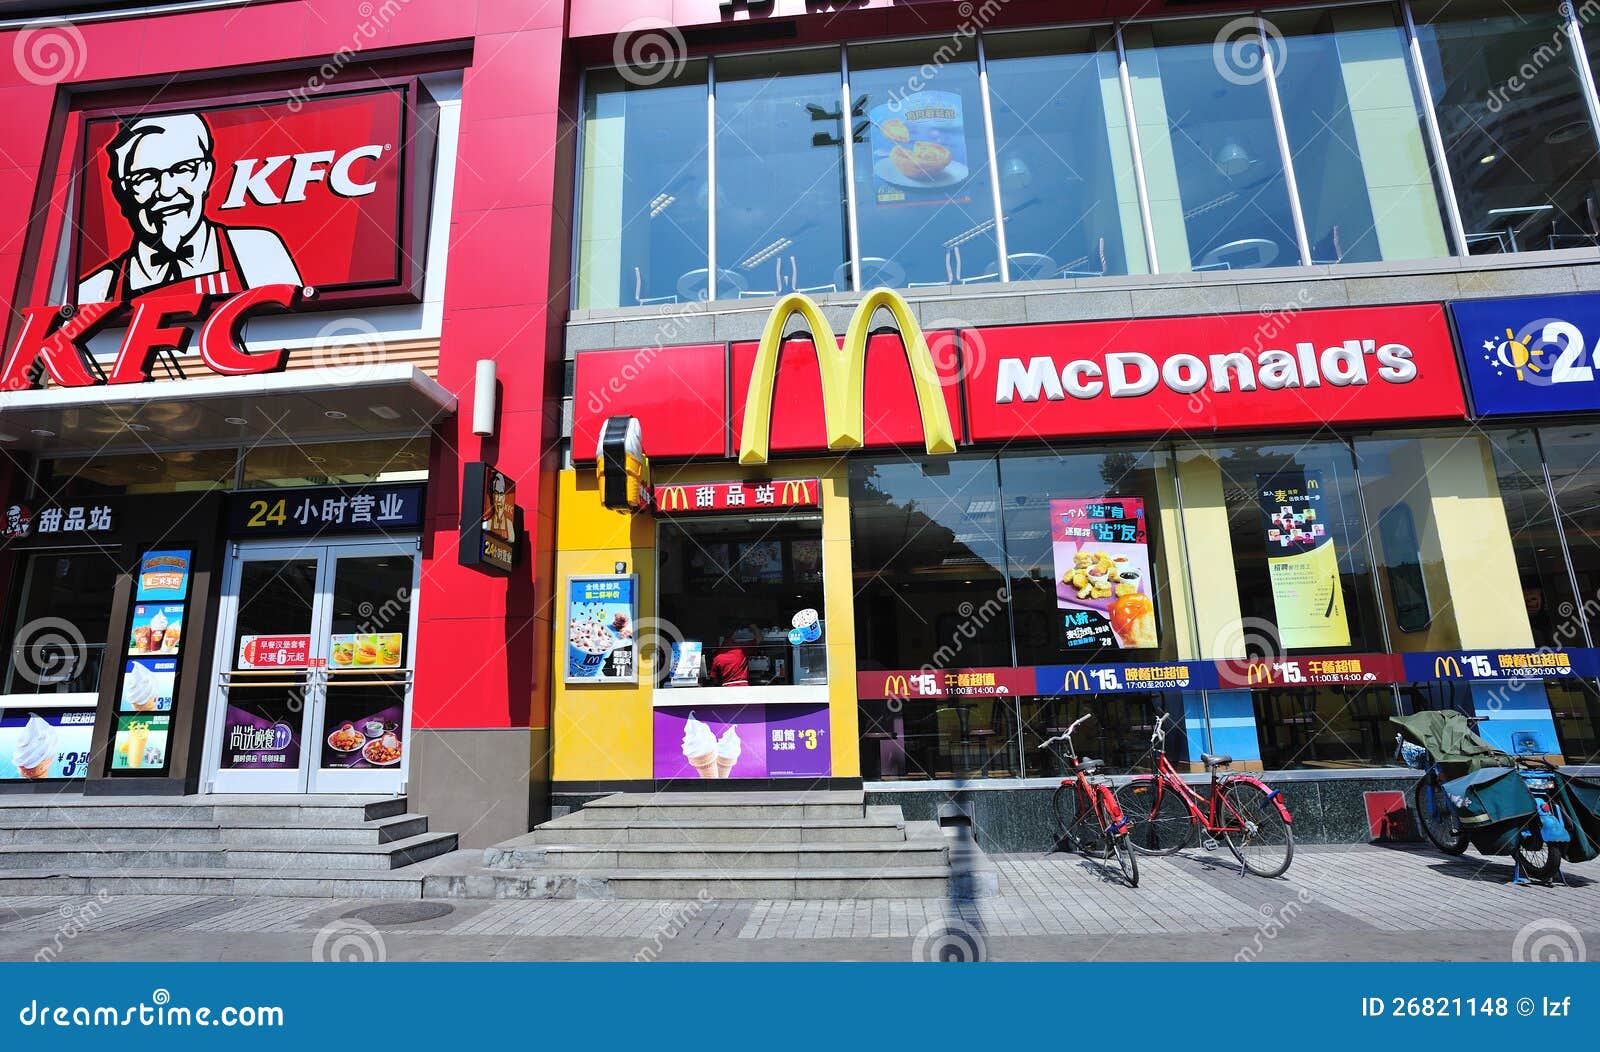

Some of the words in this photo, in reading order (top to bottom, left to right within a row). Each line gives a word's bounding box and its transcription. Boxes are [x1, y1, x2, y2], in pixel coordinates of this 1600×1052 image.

[219, 145, 382, 210] KFC
[0, 284, 302, 388] KFC
[995, 339, 1417, 404] McDonald's
[38, 506, 112, 532] 甜品站
[696, 484, 775, 507] 甜品站
